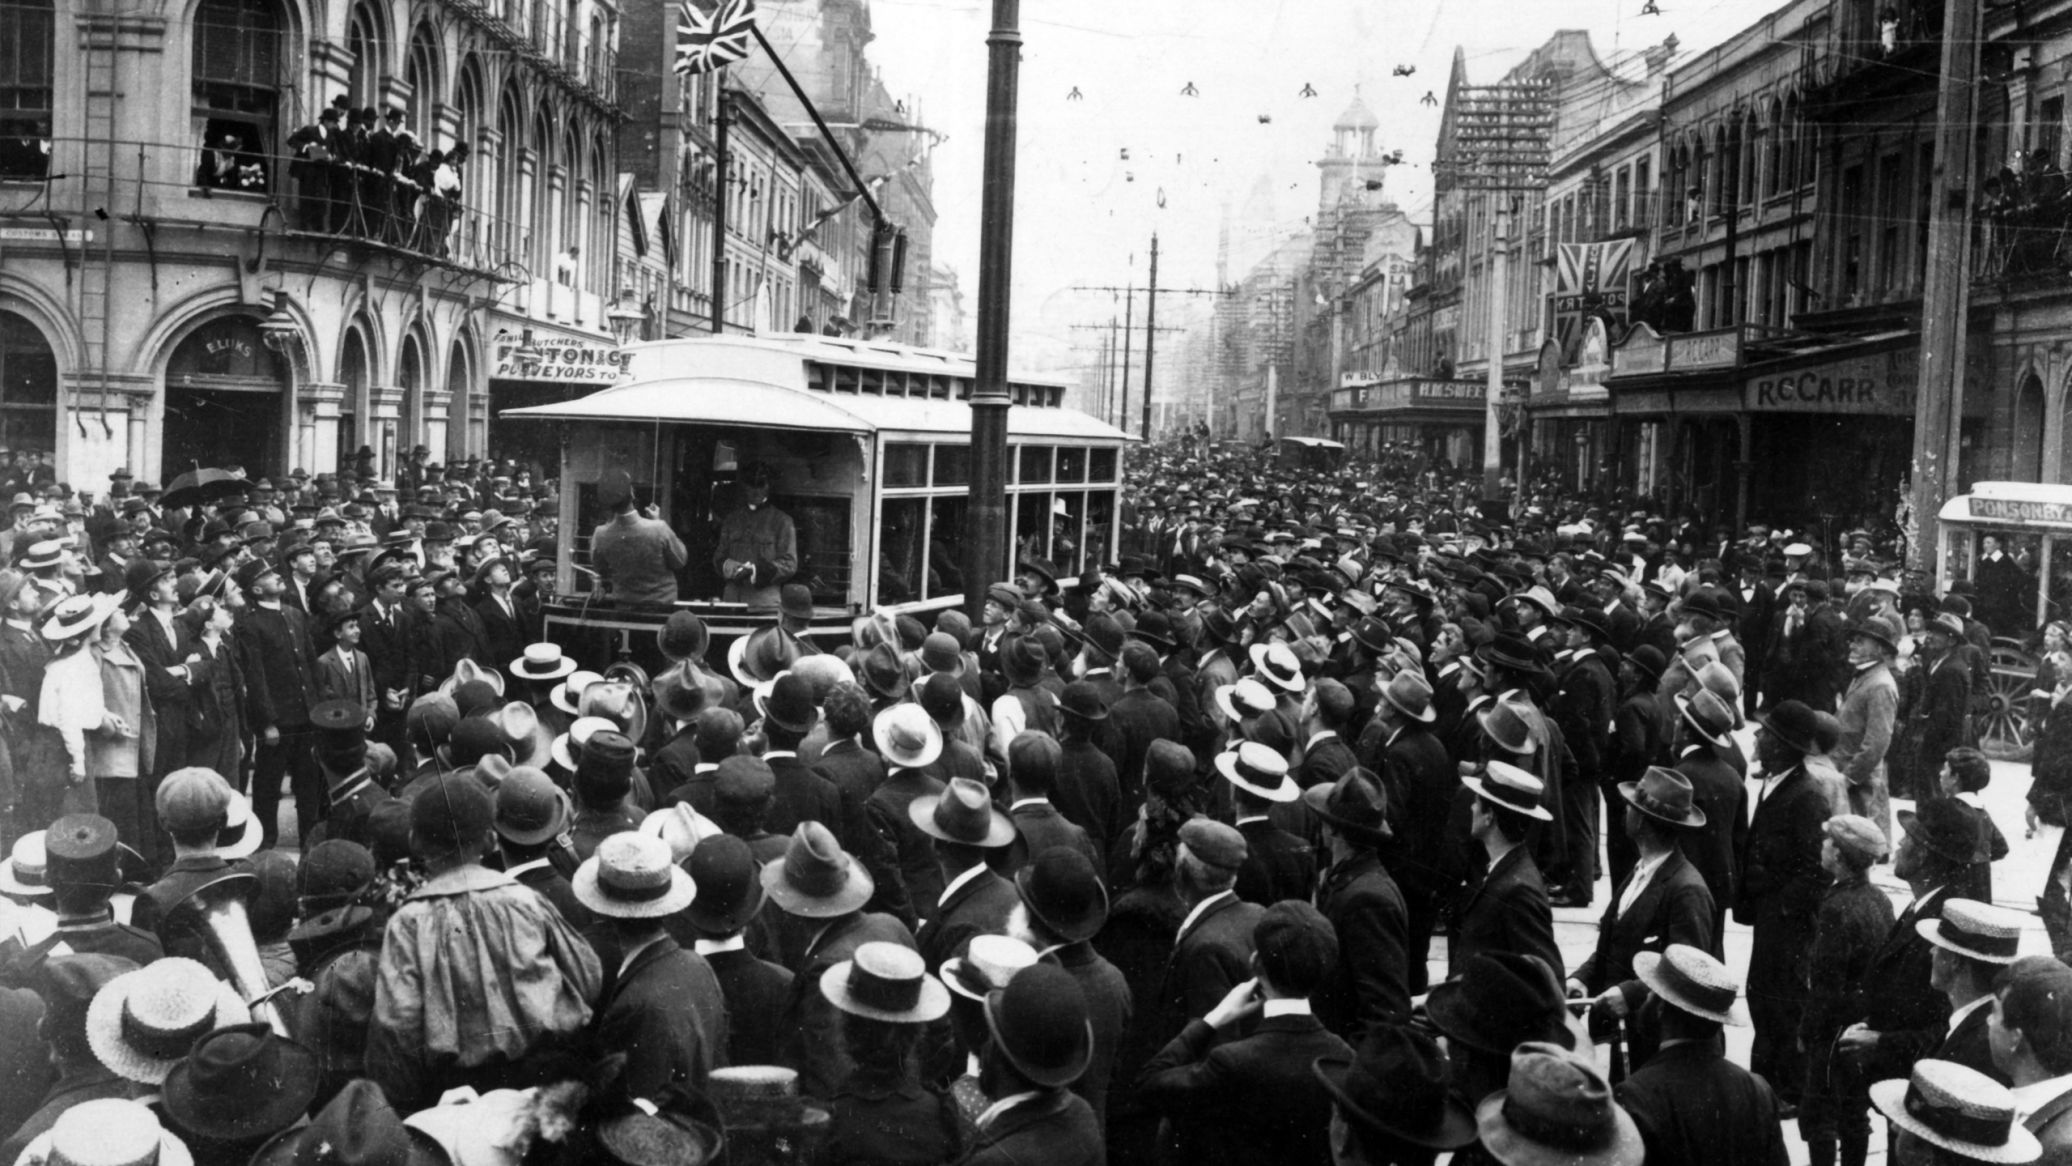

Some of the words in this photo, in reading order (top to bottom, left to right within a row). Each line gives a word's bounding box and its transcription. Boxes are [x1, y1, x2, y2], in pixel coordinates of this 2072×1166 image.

[497, 345, 595, 366] FNTON
[497, 363, 596, 380] PUVEYORS
[1972, 500, 2065, 520] PONSONBY
